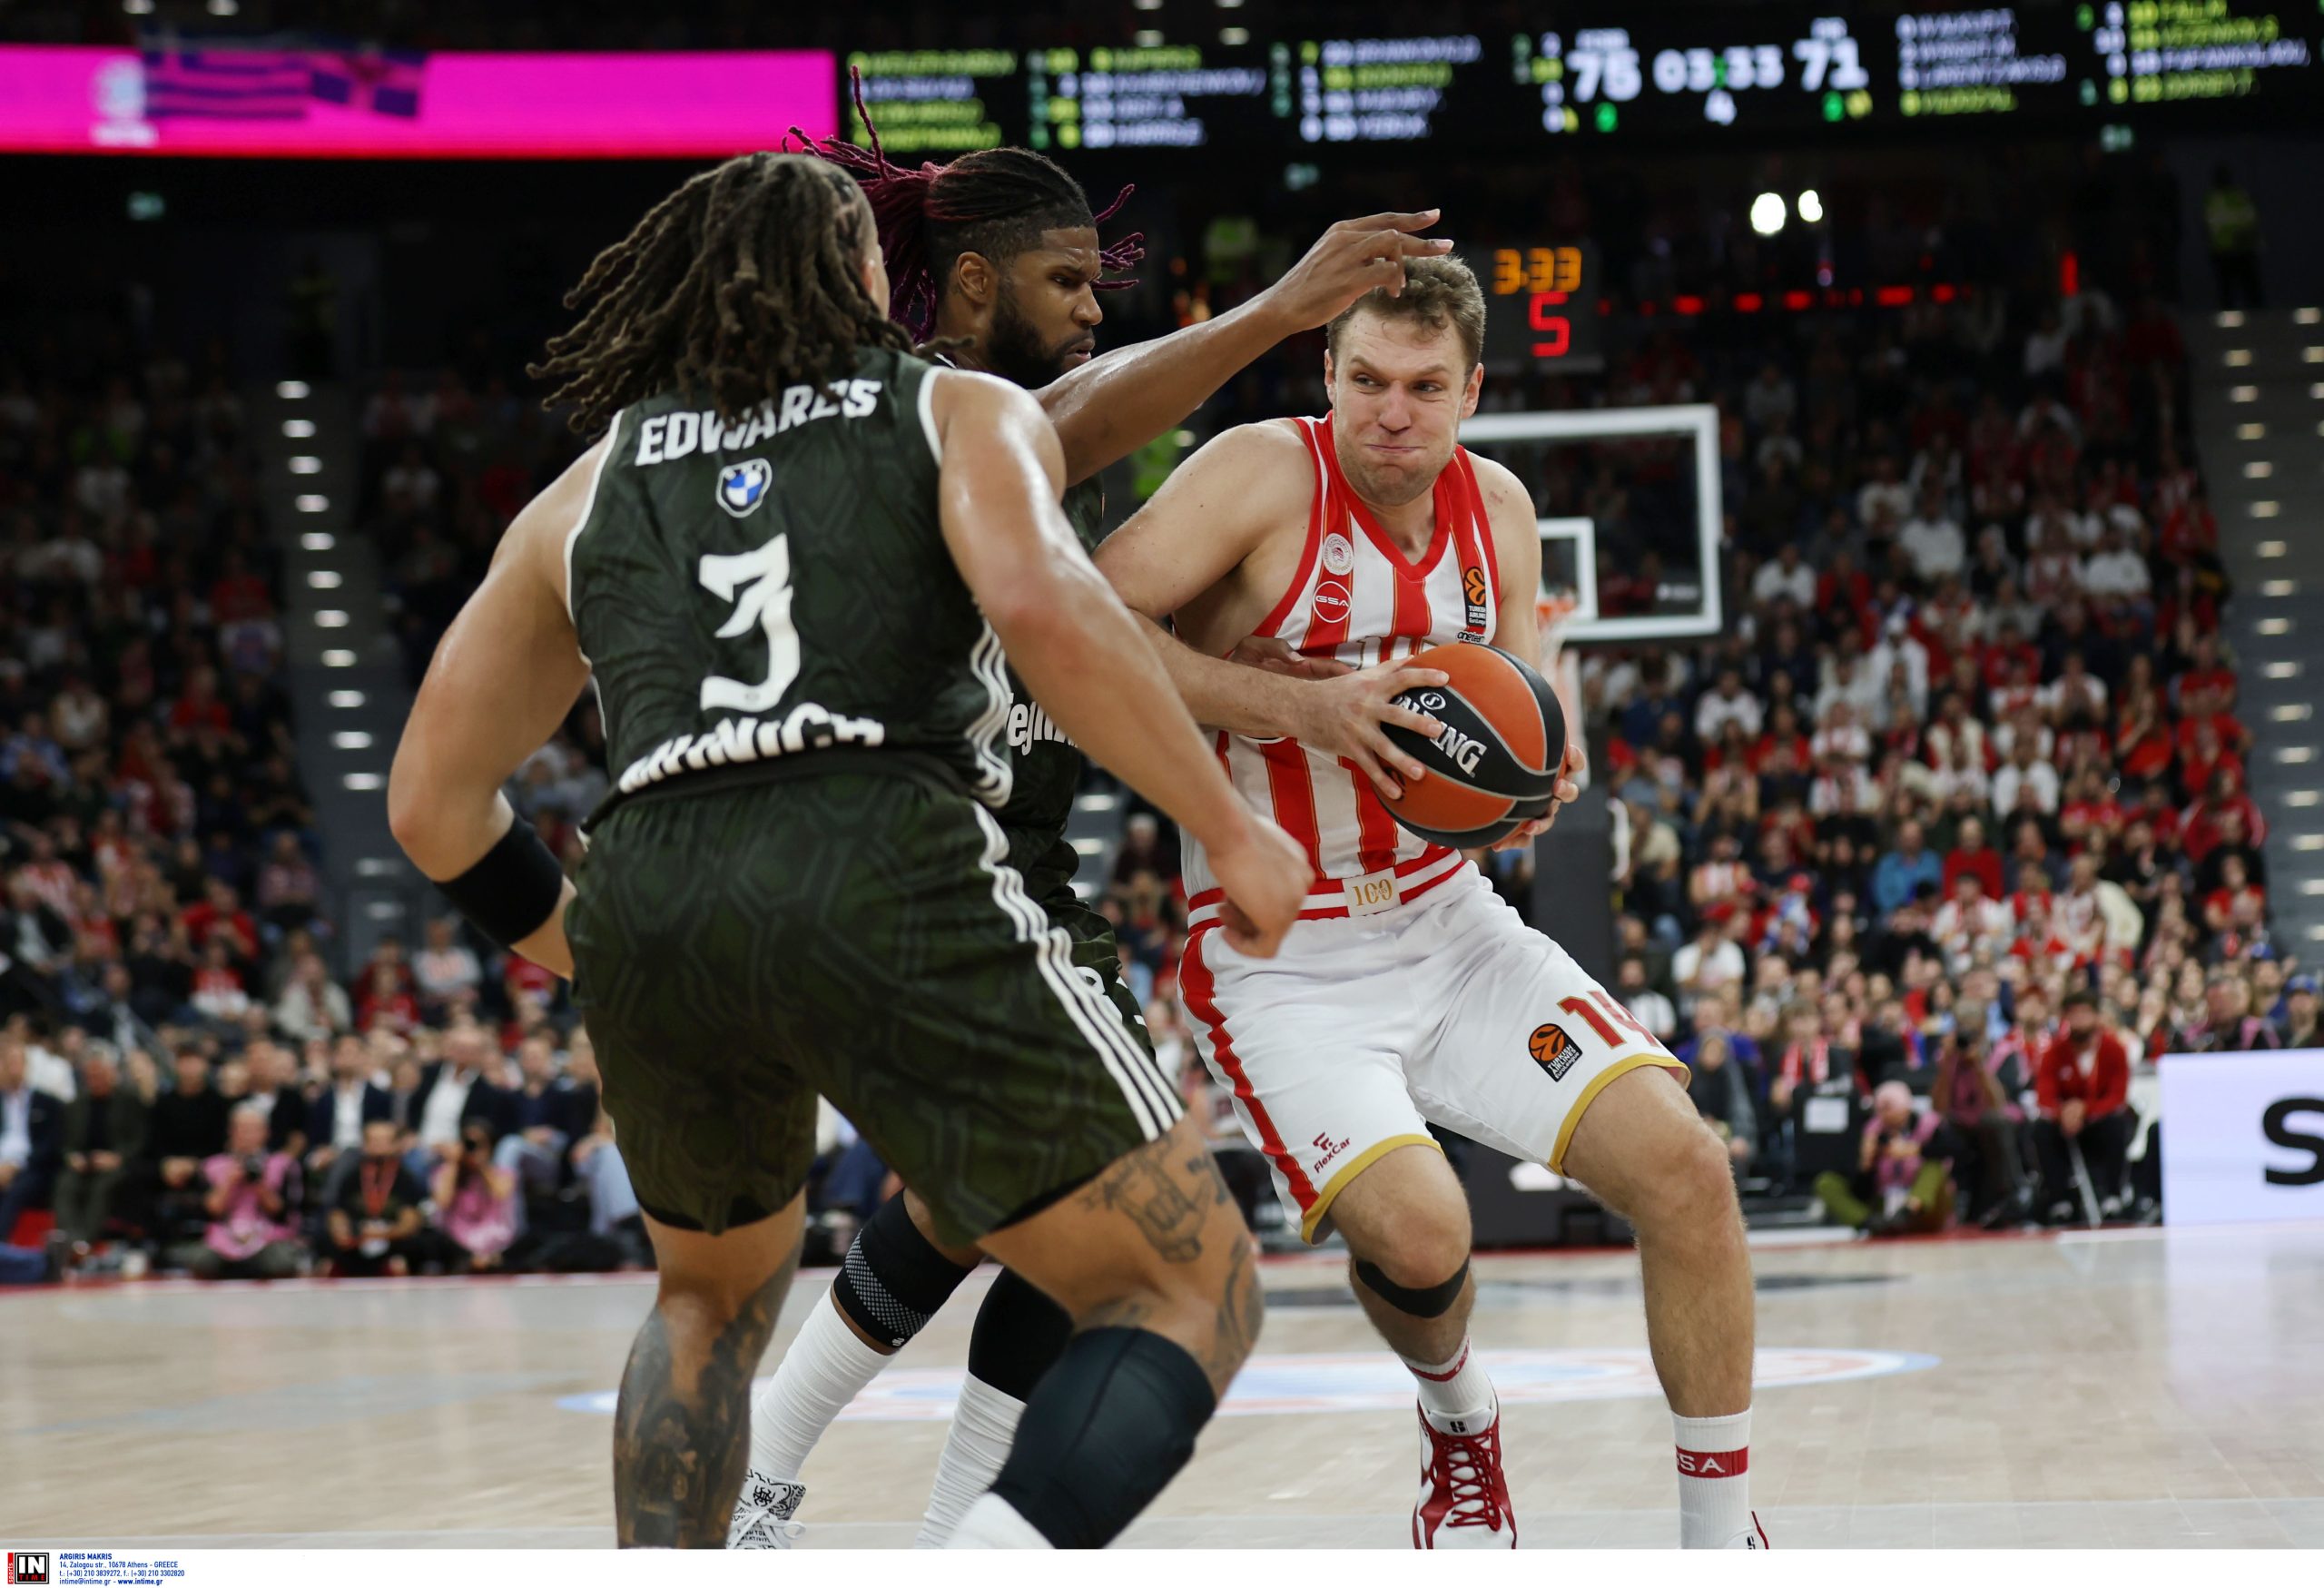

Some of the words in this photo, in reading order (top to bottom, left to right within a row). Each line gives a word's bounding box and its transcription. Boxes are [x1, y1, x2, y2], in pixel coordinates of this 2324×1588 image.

[1529, 291, 1571, 358] 5
[1315, 595, 1350, 607] GSA
[699, 532, 801, 713] 3
[1352, 879, 1393, 906] 100
[1314, 1137, 1351, 1174] FlexCar
[1677, 1453, 1726, 1474] SA
